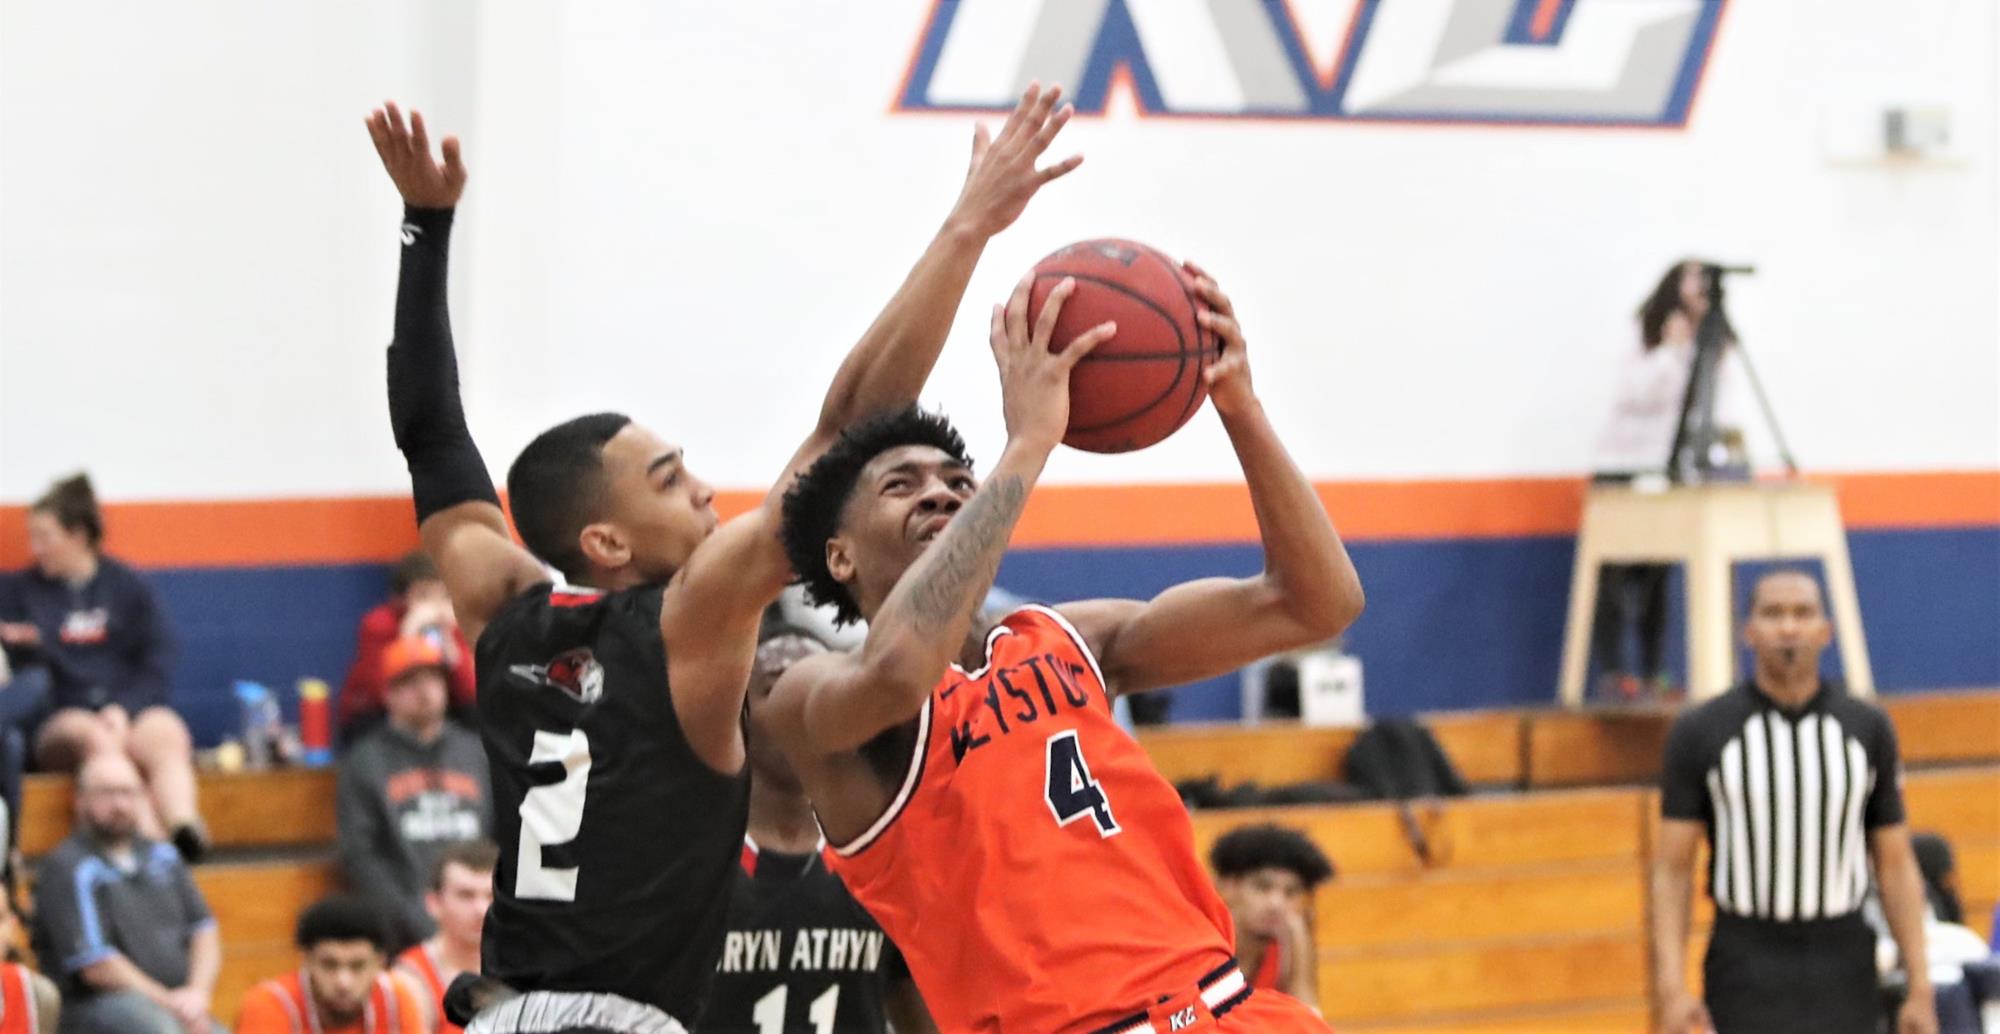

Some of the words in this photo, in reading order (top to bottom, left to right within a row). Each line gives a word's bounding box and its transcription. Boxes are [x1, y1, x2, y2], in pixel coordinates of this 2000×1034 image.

[514, 728, 592, 902] 2
[1044, 728, 1122, 839] 4
[716, 930, 782, 973] RYN
[790, 928, 884, 972] ATHYN
